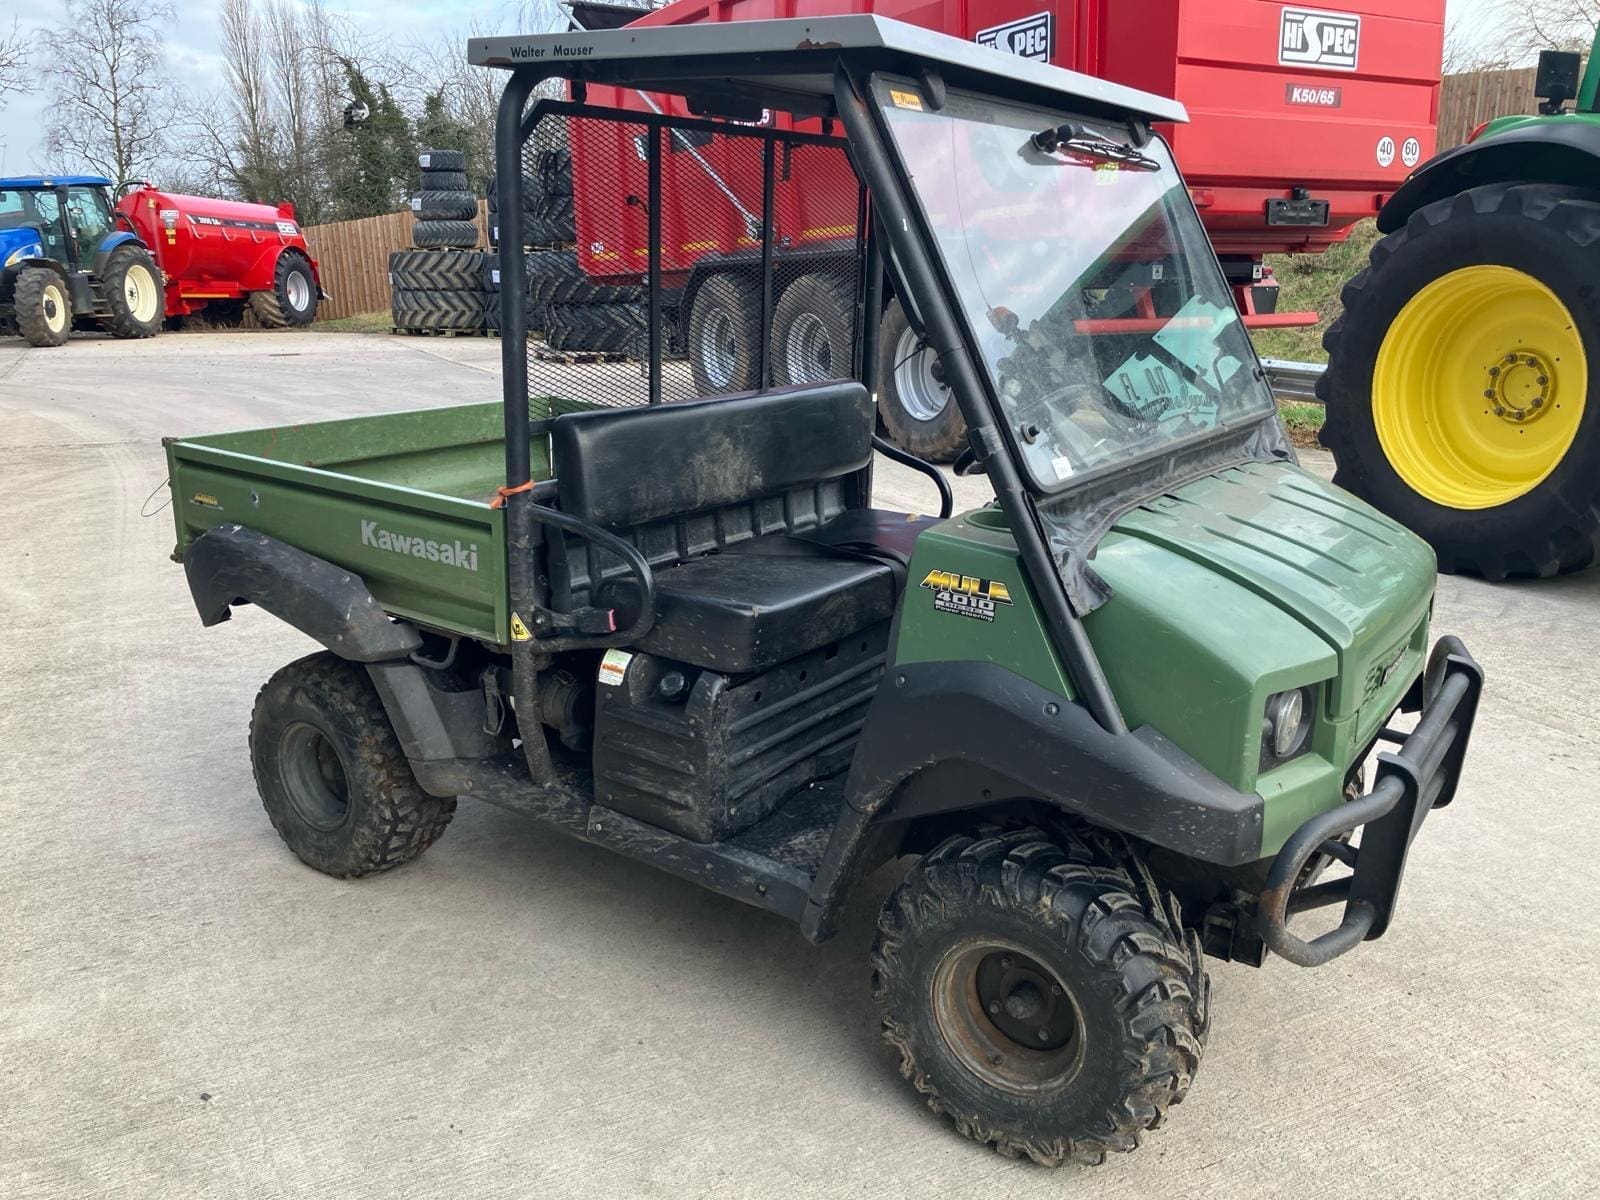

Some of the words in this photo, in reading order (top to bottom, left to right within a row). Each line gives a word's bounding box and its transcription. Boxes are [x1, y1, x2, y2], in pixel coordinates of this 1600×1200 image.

[510, 46, 545, 58] Walter
[553, 44, 594, 57] Mauser
[1292, 87, 1335, 105] K50/65
[1380, 141, 1392, 155] 40
[1405, 141, 1417, 156] 60
[360, 519, 478, 572] Kawasaki
[919, 569, 1014, 606] MULE
[936, 591, 995, 611] 4010
[935, 604, 959, 614] Power
[961, 610, 993, 622] steering
